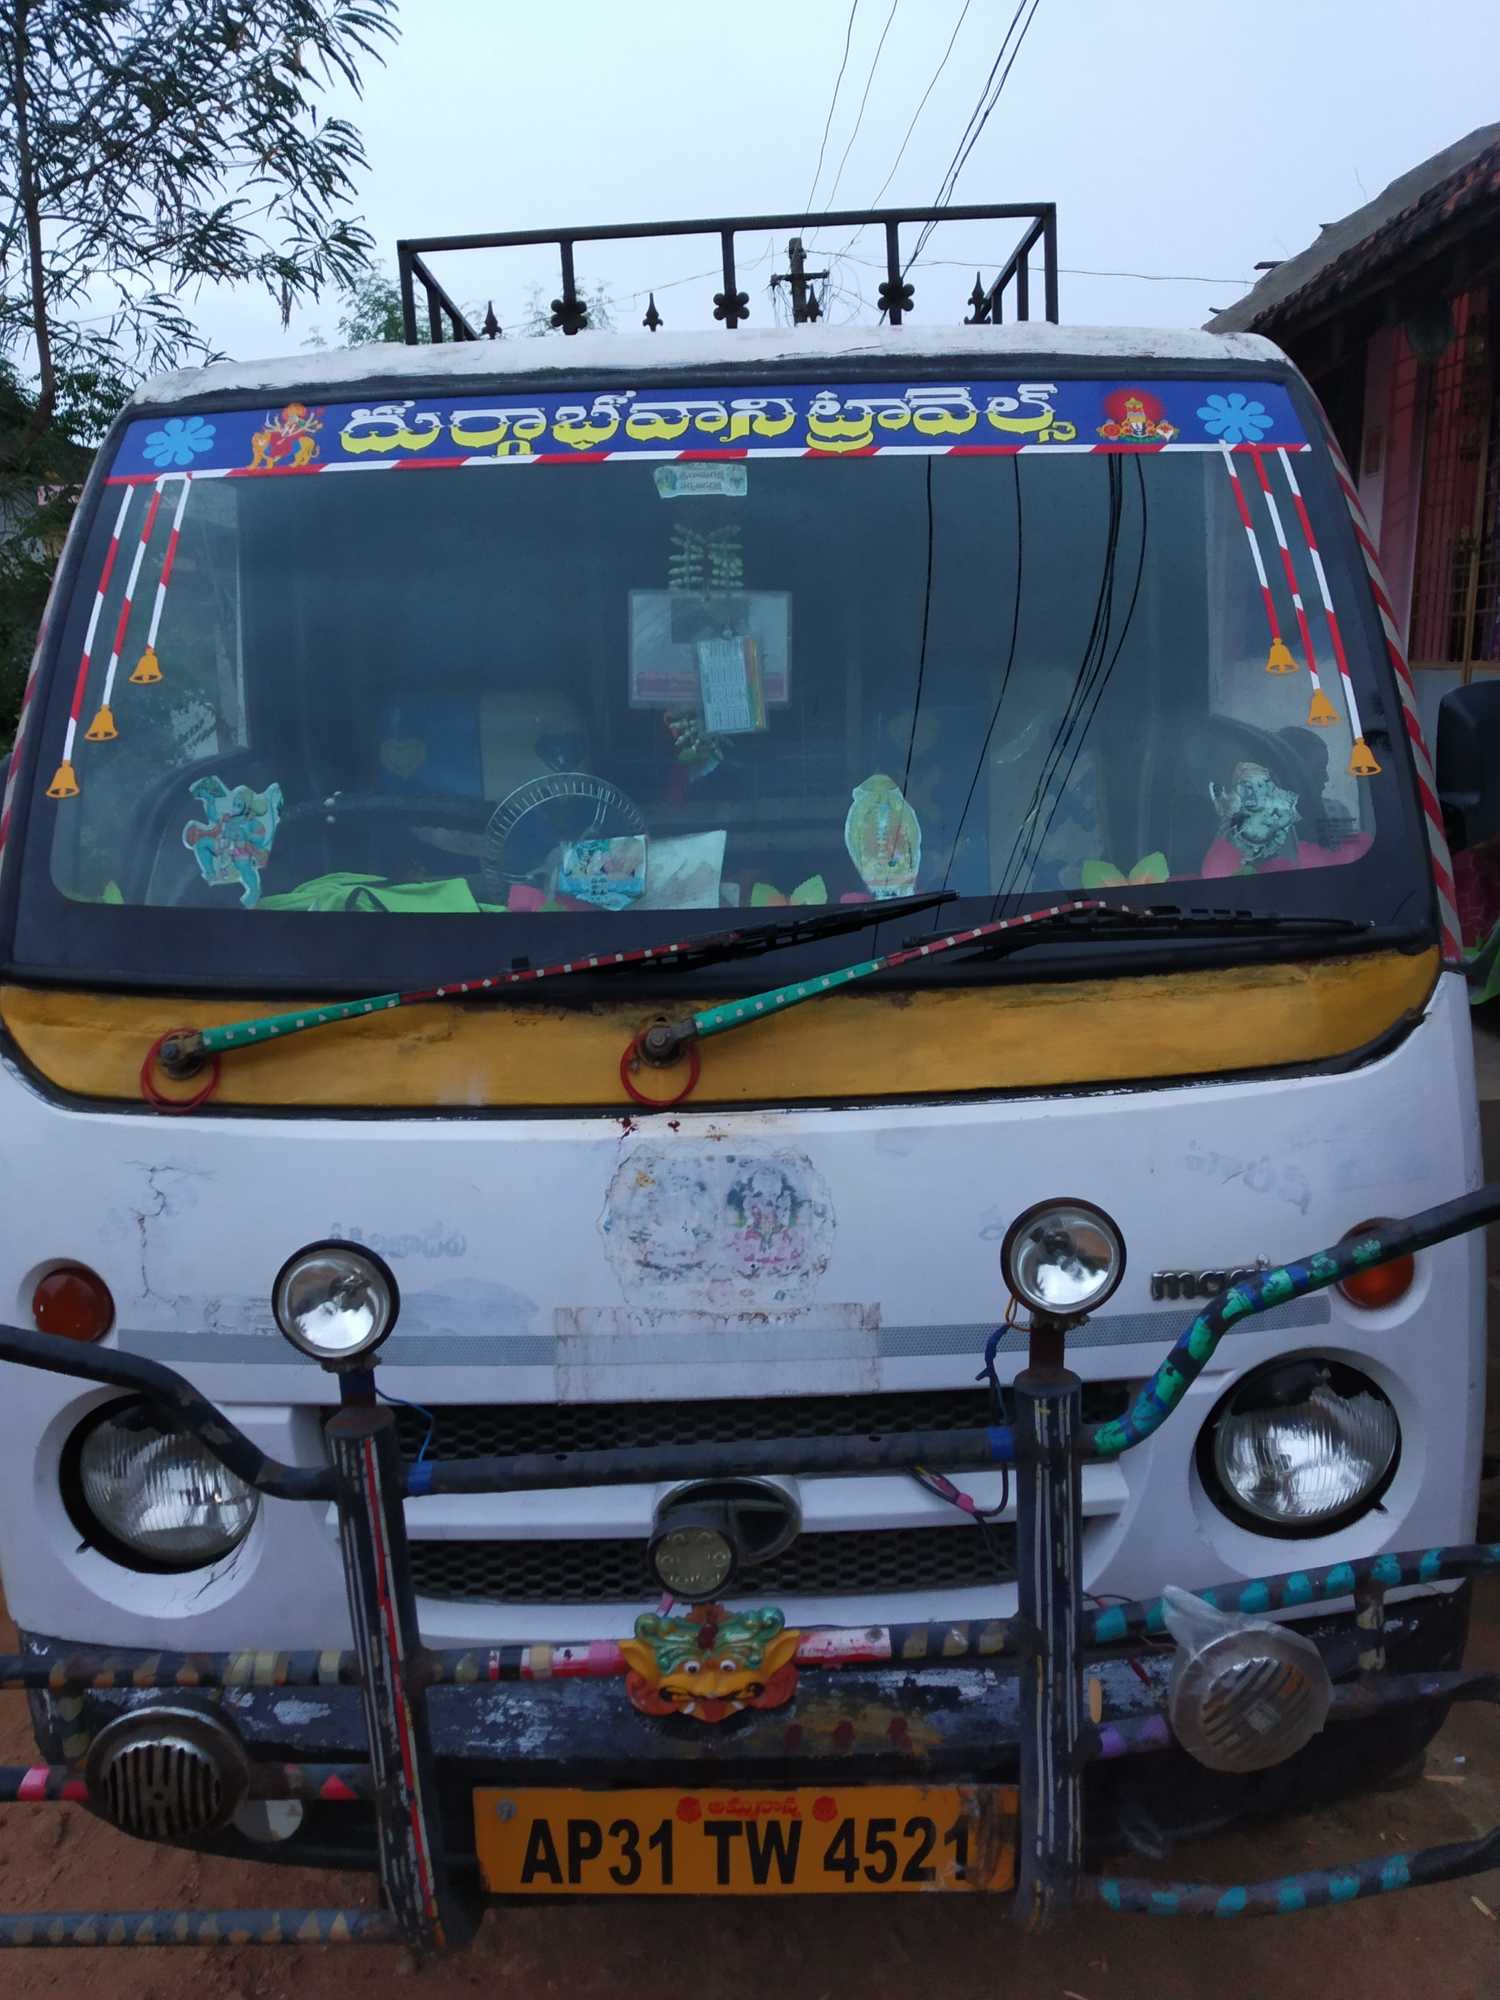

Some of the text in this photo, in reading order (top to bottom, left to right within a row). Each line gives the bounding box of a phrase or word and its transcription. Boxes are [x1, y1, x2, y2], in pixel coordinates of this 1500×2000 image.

[519, 1815, 970, 1885] AP31 TW 4521
